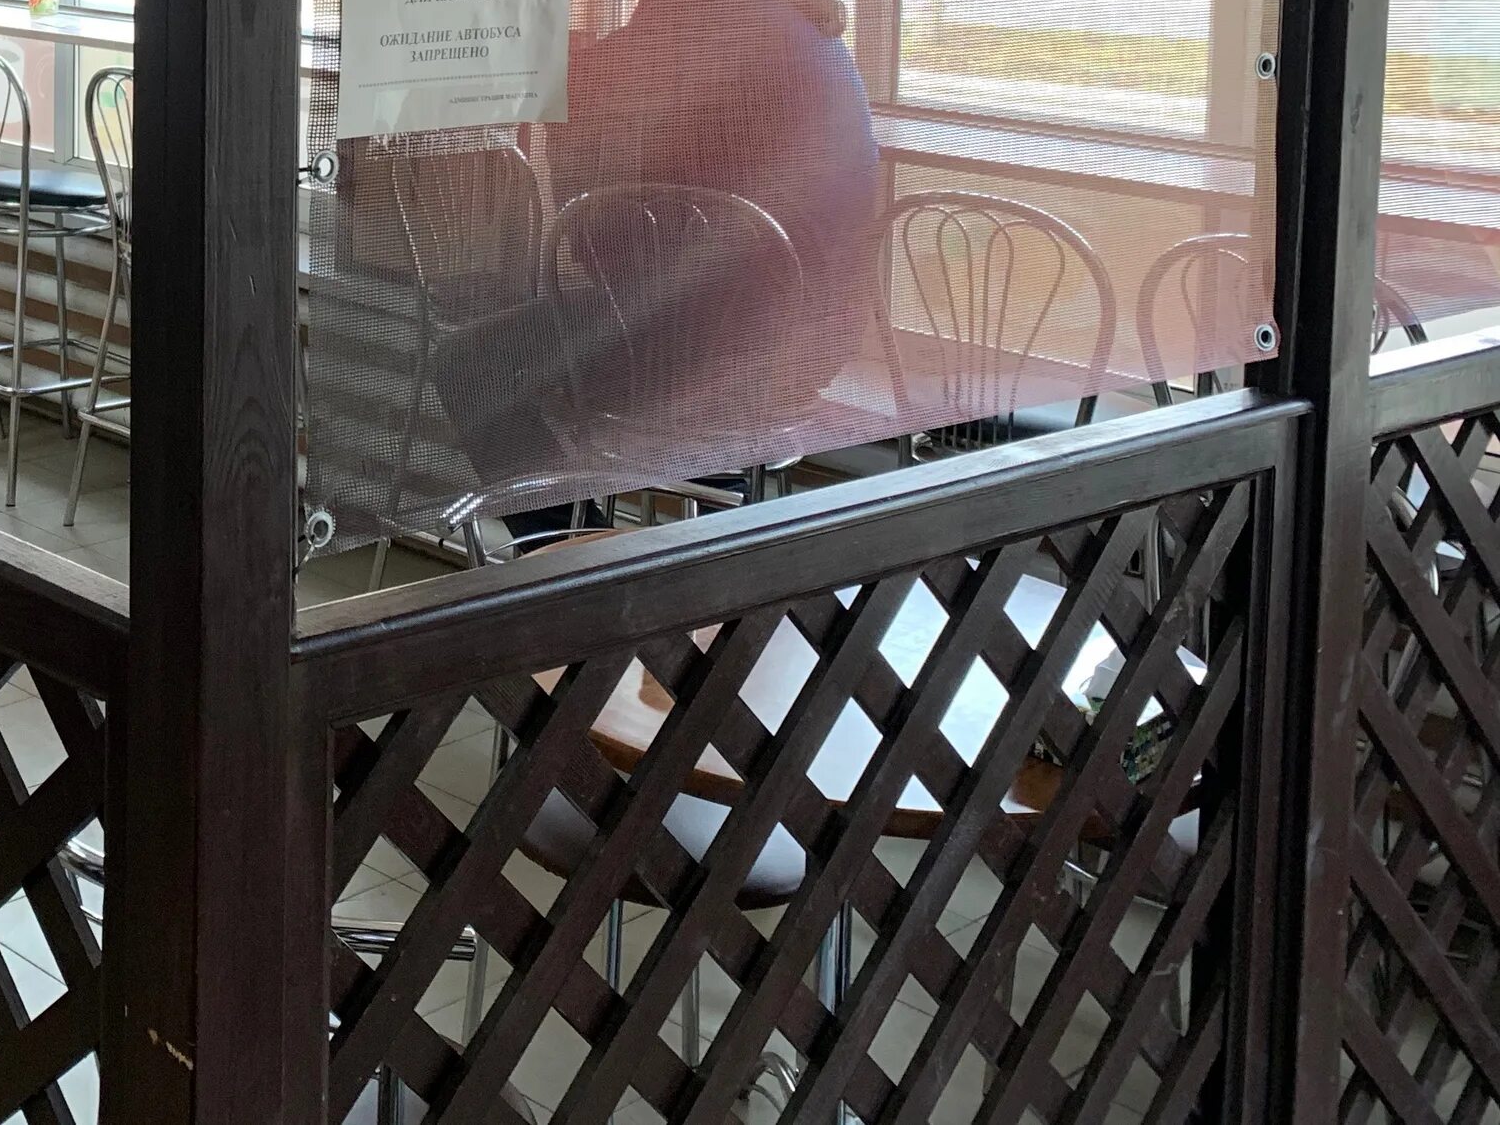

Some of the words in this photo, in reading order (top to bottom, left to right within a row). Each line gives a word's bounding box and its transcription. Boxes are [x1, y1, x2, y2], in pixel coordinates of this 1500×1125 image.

[380, 30, 452, 47] ОЖИДАНИЕ
[457, 26, 521, 41] АВТОБУСА
[410, 46, 489, 62] ЗАПРЕЩЕНО
